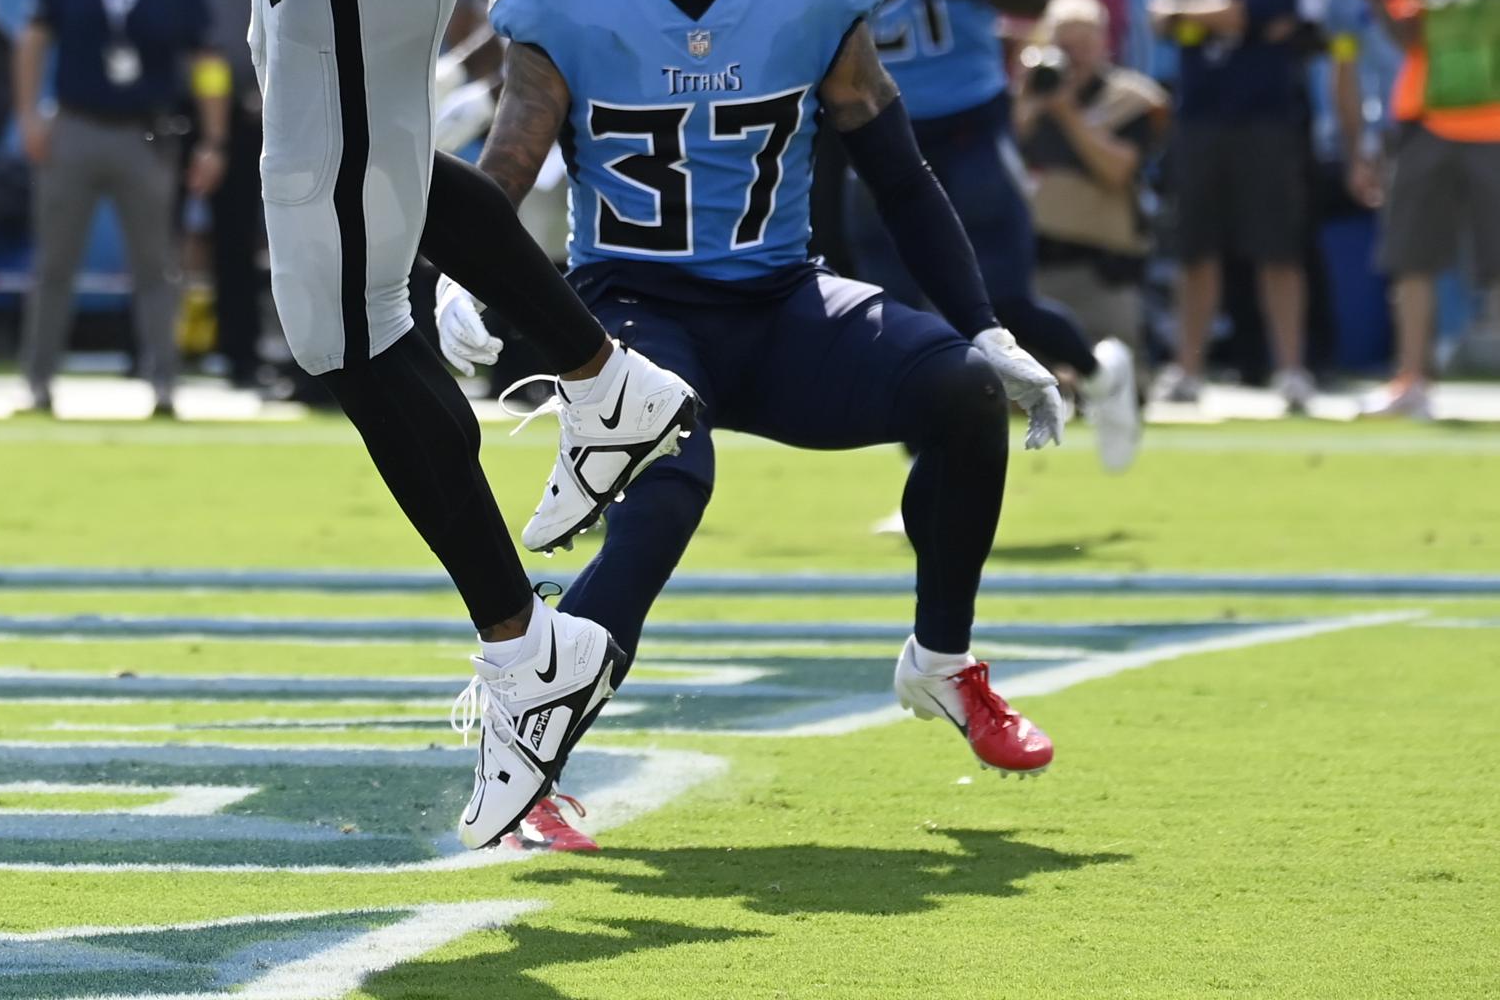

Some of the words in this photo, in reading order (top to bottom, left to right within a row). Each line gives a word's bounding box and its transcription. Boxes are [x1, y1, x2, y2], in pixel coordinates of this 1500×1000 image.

[661, 62, 743, 97] TITANS
[587, 83, 815, 257] 37
[531, 708, 553, 748] ALPHA
